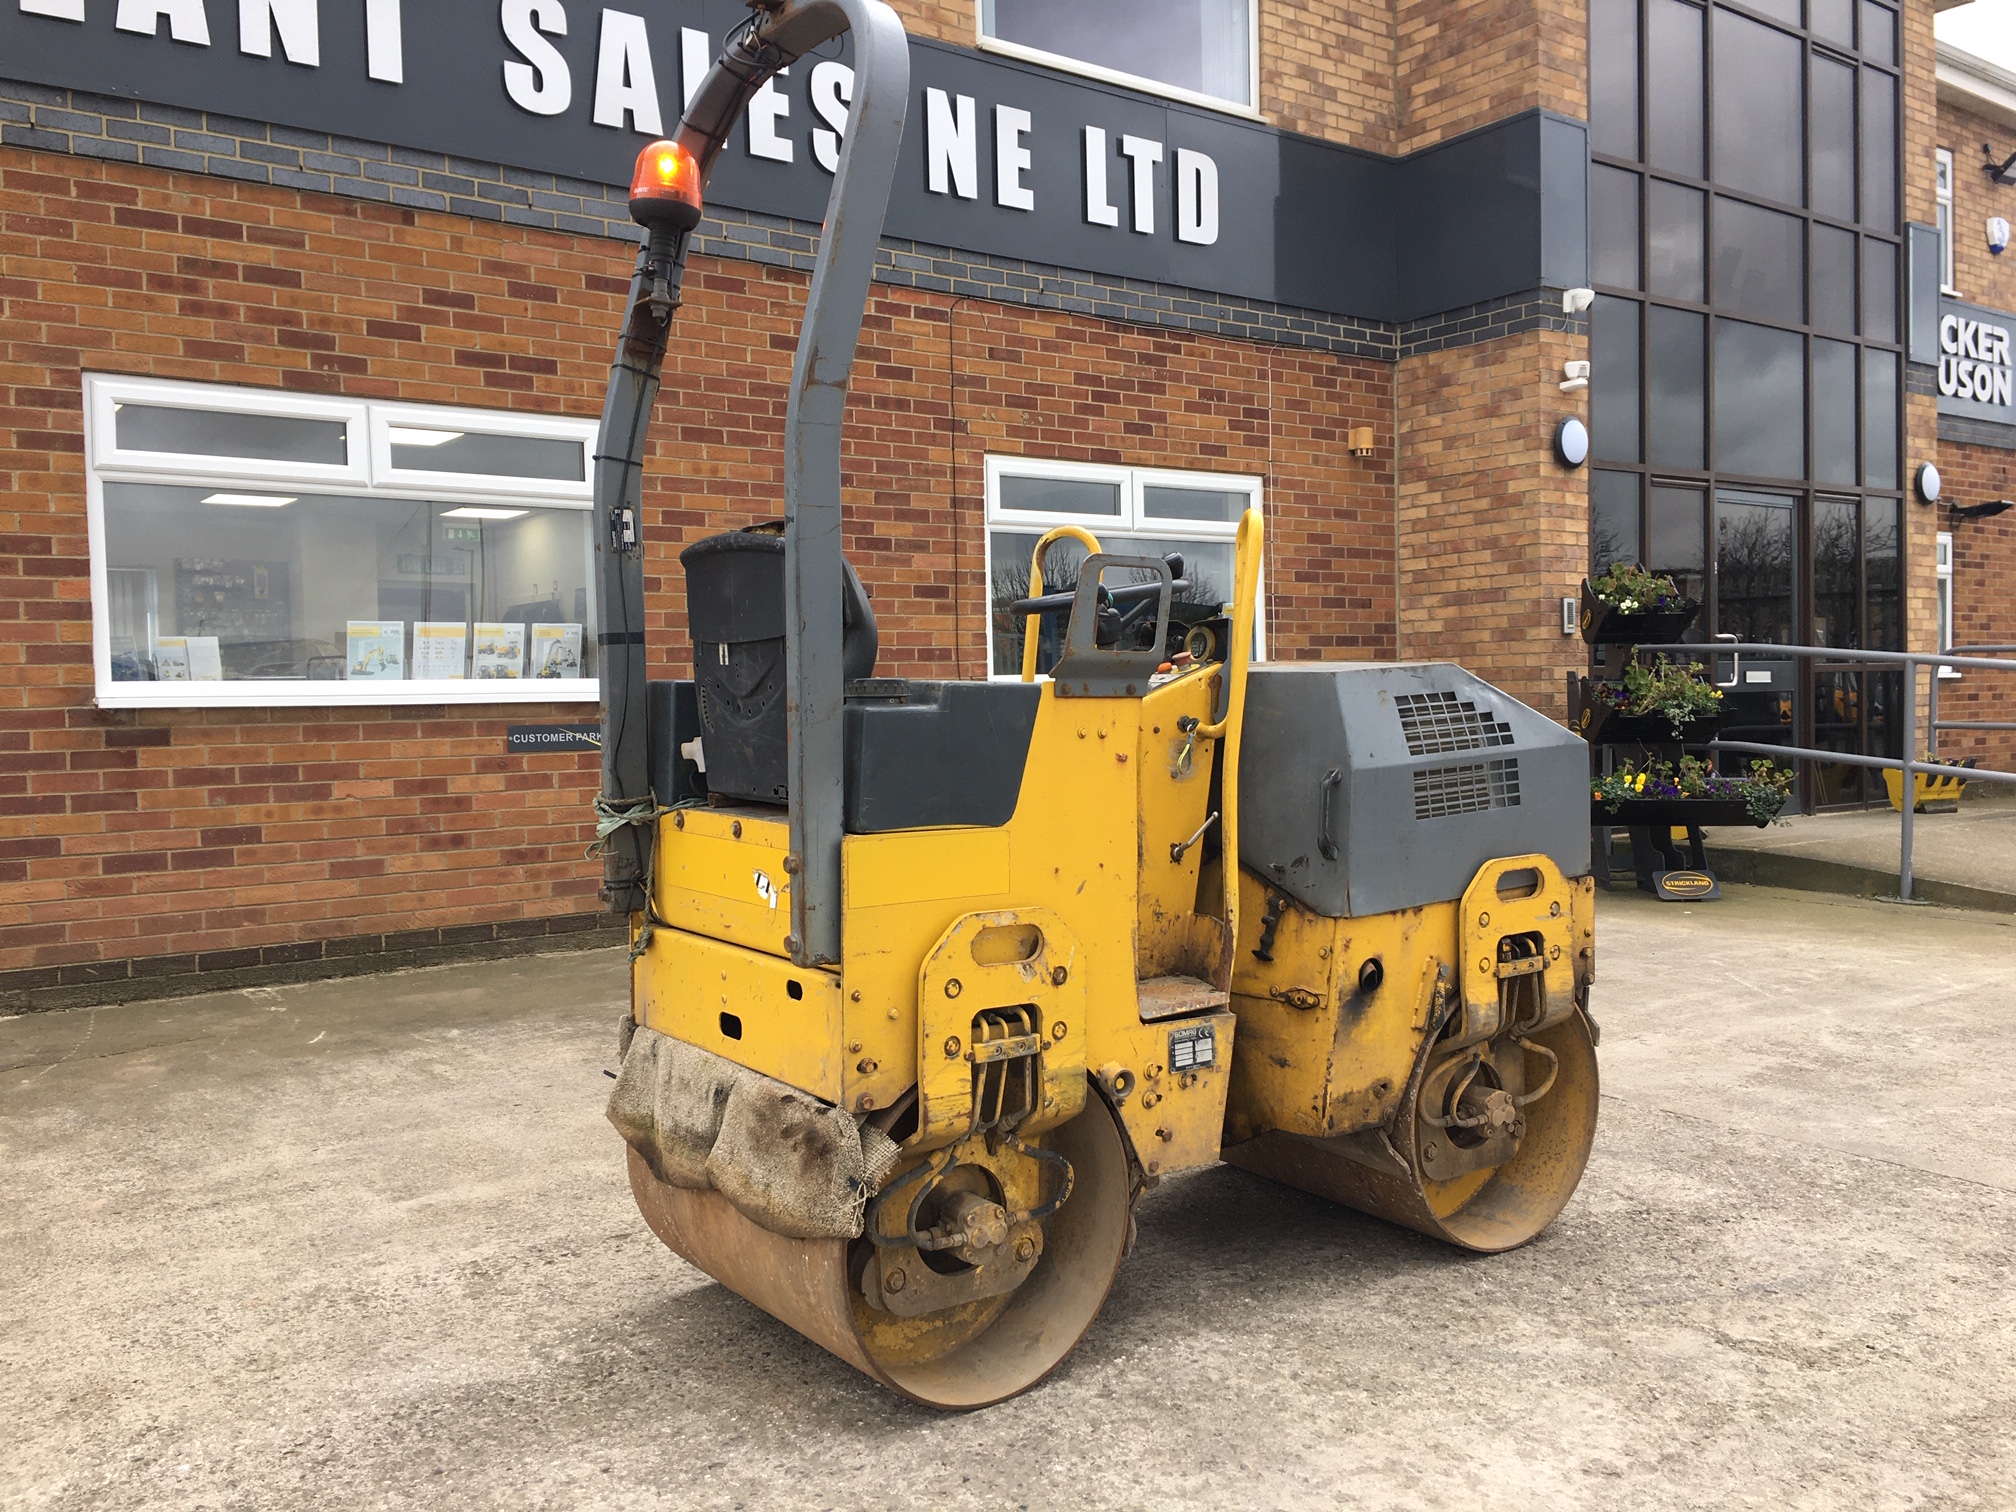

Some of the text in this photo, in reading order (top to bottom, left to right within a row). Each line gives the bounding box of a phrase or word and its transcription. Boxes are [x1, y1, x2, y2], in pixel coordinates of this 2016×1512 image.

[926, 87, 1034, 211] NE
[1086, 125, 1219, 245] LTD
[1941, 314, 2011, 366] CKER
[1939, 355, 2012, 406] USON
[513, 733, 573, 743] CUSTOMER
[1174, 1028, 1197, 1038] BOMAG
